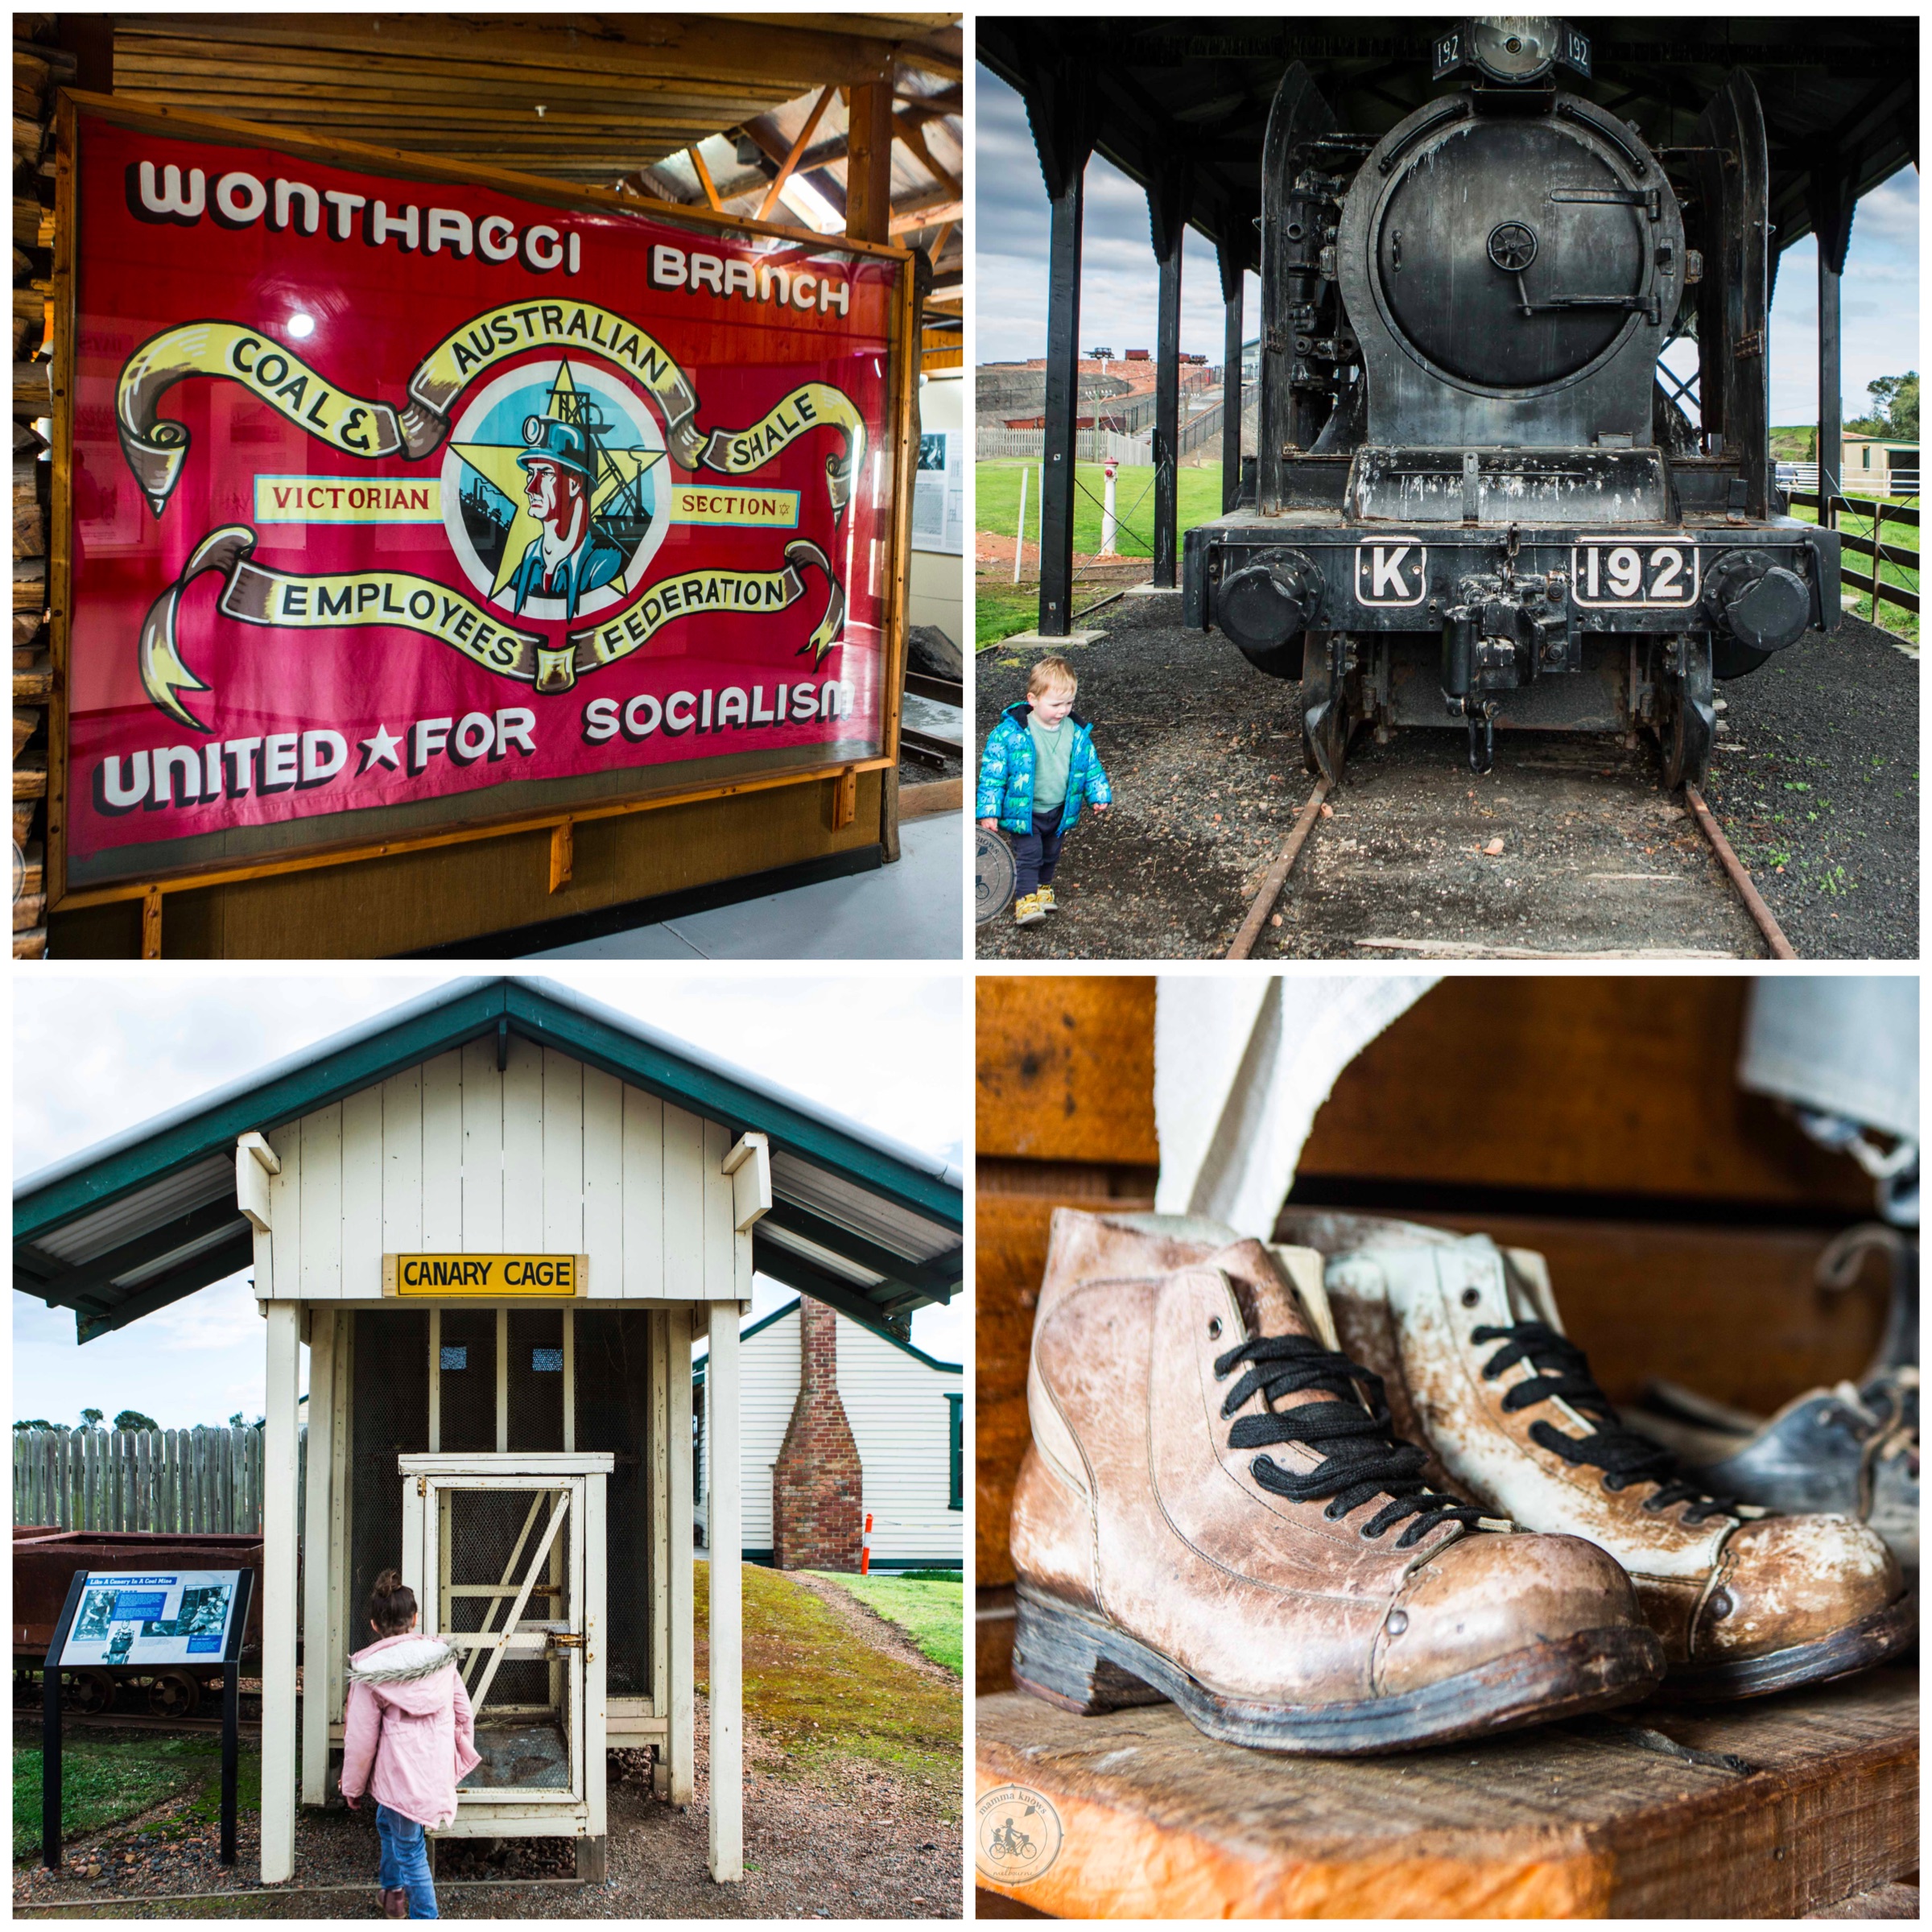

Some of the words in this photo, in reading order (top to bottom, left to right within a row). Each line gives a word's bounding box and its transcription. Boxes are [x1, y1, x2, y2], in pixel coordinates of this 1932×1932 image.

[1438, 35, 1459, 68] 192
[1569, 33, 1587, 66] 192
[127, 160, 581, 275] WONTHAGGI
[648, 244, 850, 316] BRANCH
[452, 305, 669, 383] AUSTRALIAN
[232, 337, 329, 431] COAL
[731, 392, 819, 466] SHALE
[272, 486, 430, 510] VICTORIAN
[681, 493, 777, 517] SECTION
[1373, 547, 1410, 597] K
[1587, 547, 1684, 598] 192
[282, 583, 518, 667] EMPLOYEES
[602, 577, 786, 655] FEDERATION
[94, 729, 349, 816] UNITED
[408, 708, 537, 777] FOR
[583, 679, 855, 745] SOCIALISM
[403, 1261, 493, 1286] CANARY
[503, 1261, 571, 1286] CAGE
